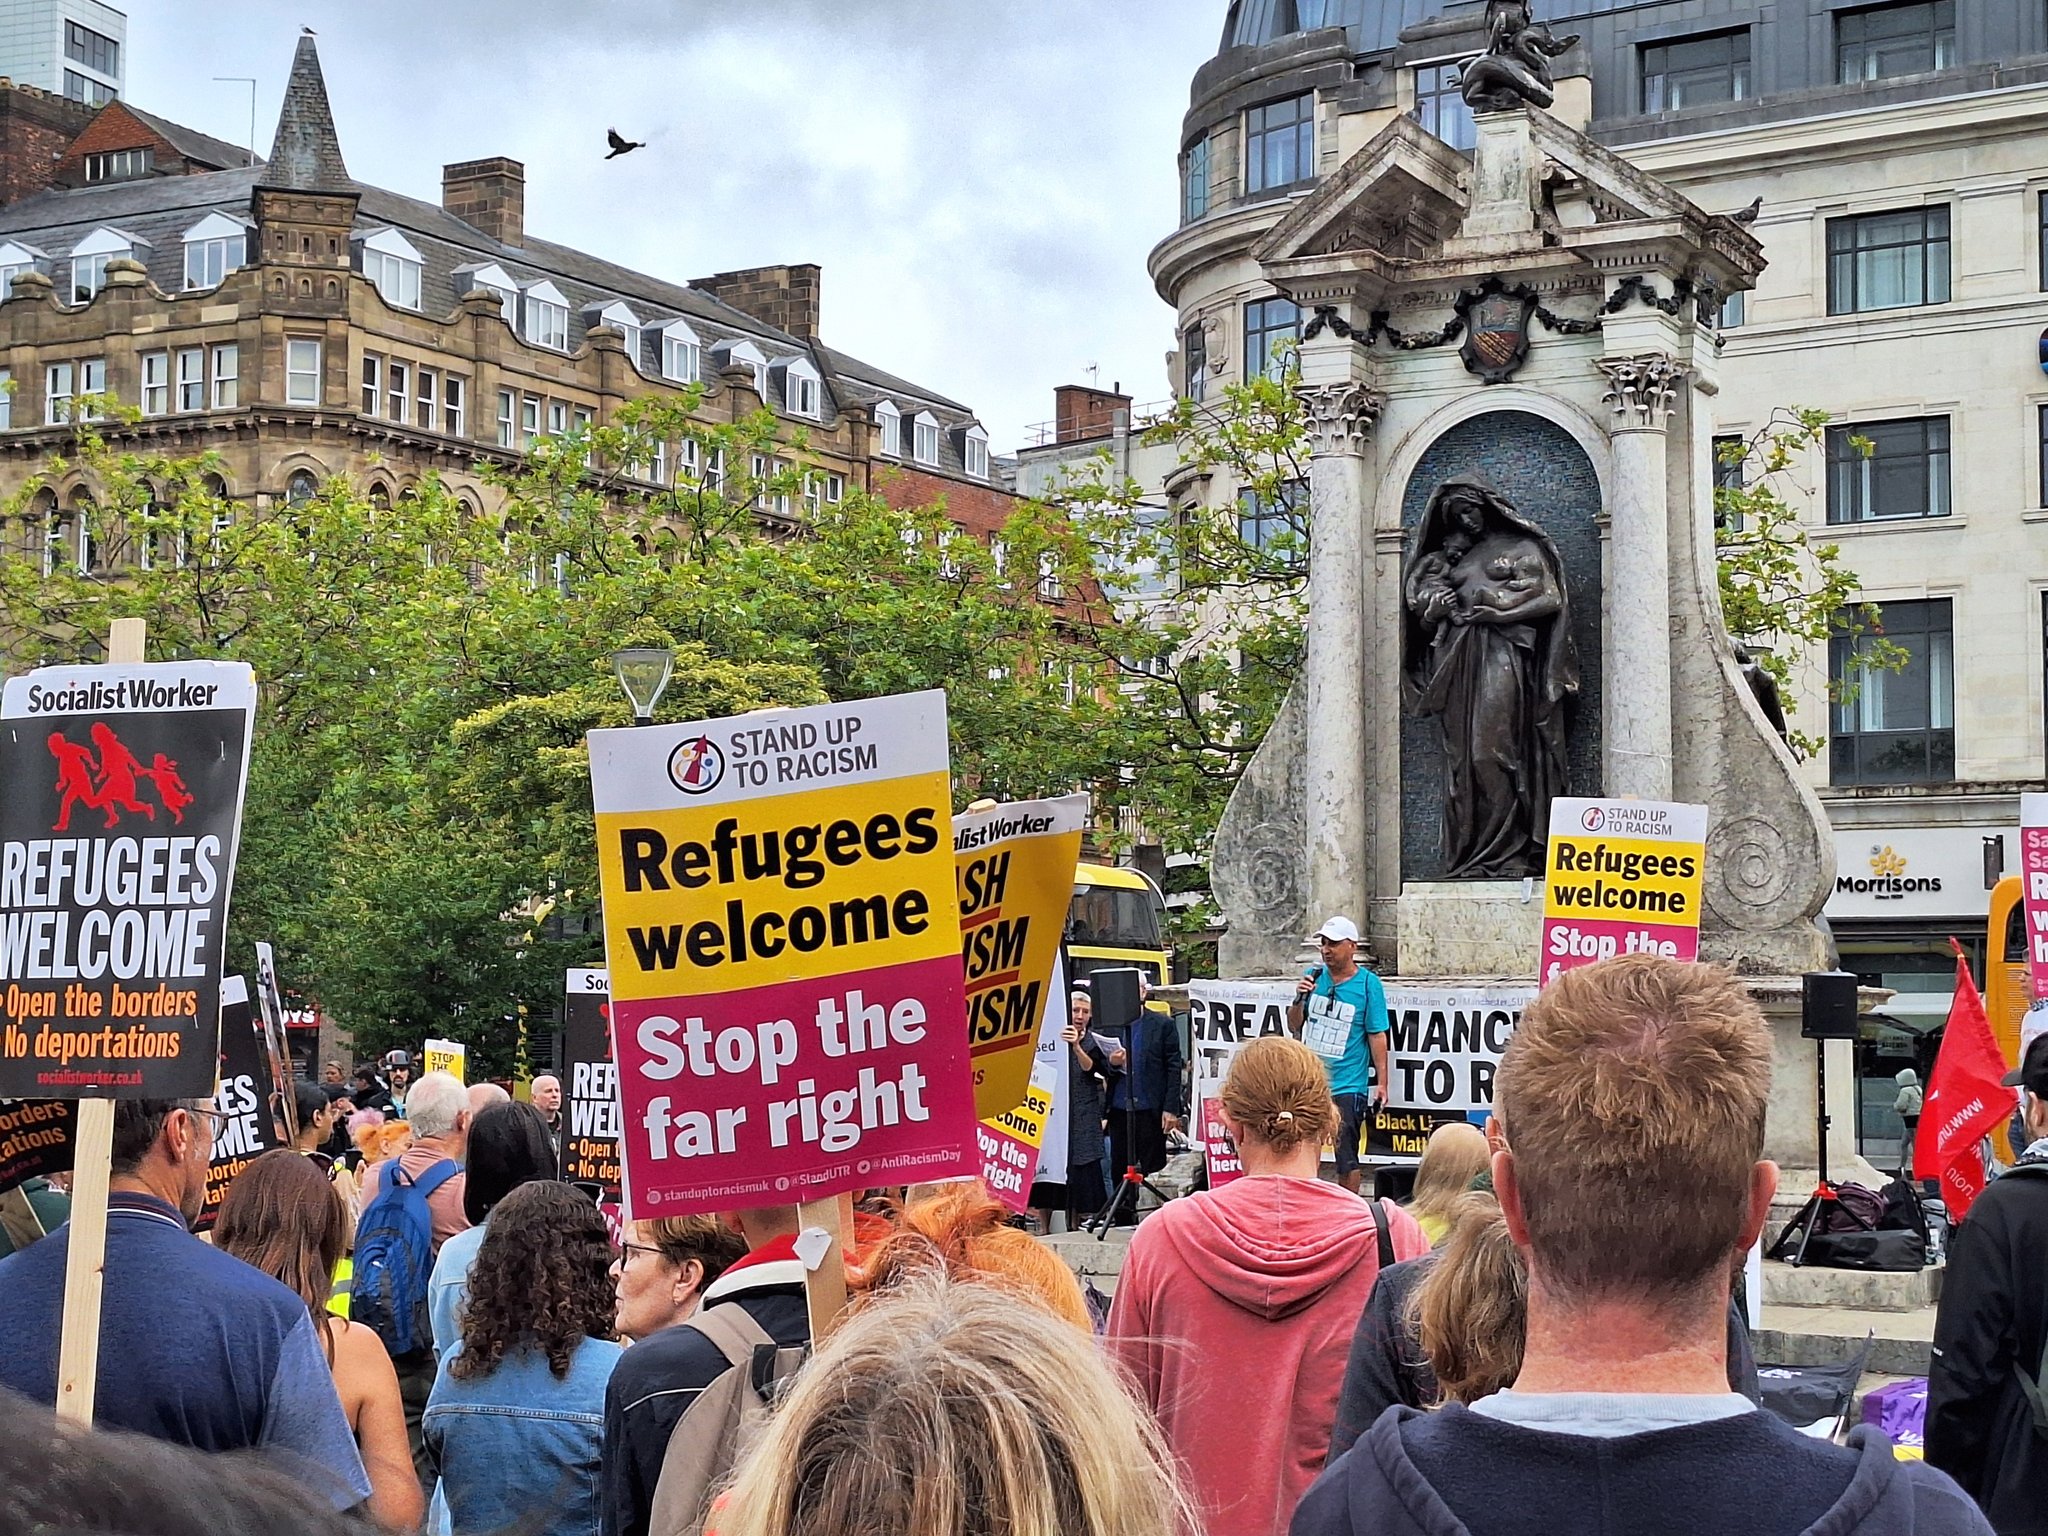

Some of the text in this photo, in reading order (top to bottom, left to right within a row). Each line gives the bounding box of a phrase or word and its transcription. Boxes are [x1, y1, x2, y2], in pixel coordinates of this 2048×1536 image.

[730, 716, 862, 759] STAND UP
[732, 744, 878, 789] TO RACISM
[1608, 808, 1667, 821] STAND UP
[1608, 820, 1673, 836] TO RACISM
[1, 834, 221, 908] REFUGEES
[619, 807, 939, 893] Refugees
[1556, 843, 1695, 880] Refugees
[955, 850, 1011, 915] SH
[1554, 880, 1685, 912] welcome
[1836, 872, 1942, 893] Morrisons
[0, 908, 211, 980] WELCOME
[627, 889, 930, 972] welcome
[1550, 925, 1677, 960] Stop the
[6, 983, 197, 1026] Open the borders
[1190, 998, 1292, 1042] GREA
[4, 1024, 181, 1067] No deportations
[431, 1052, 455, 1064] STOP
[636, 990, 926, 1086] Stop the
[37, 1070, 144, 1085] socialistworker.co.uk
[1396, 1059, 1455, 1103] TO
[643, 1062, 930, 1161] far right
[1375, 1114, 1415, 1131] Black
[578, 1160, 595, 1178] No
[580, 1138, 611, 1160] Open
[1002, 1140, 1028, 1169] the
[664, 1149, 962, 1201] standuptoracismuk @StandUTR @AntiRacismDay
[983, 1161, 1023, 1194] right
